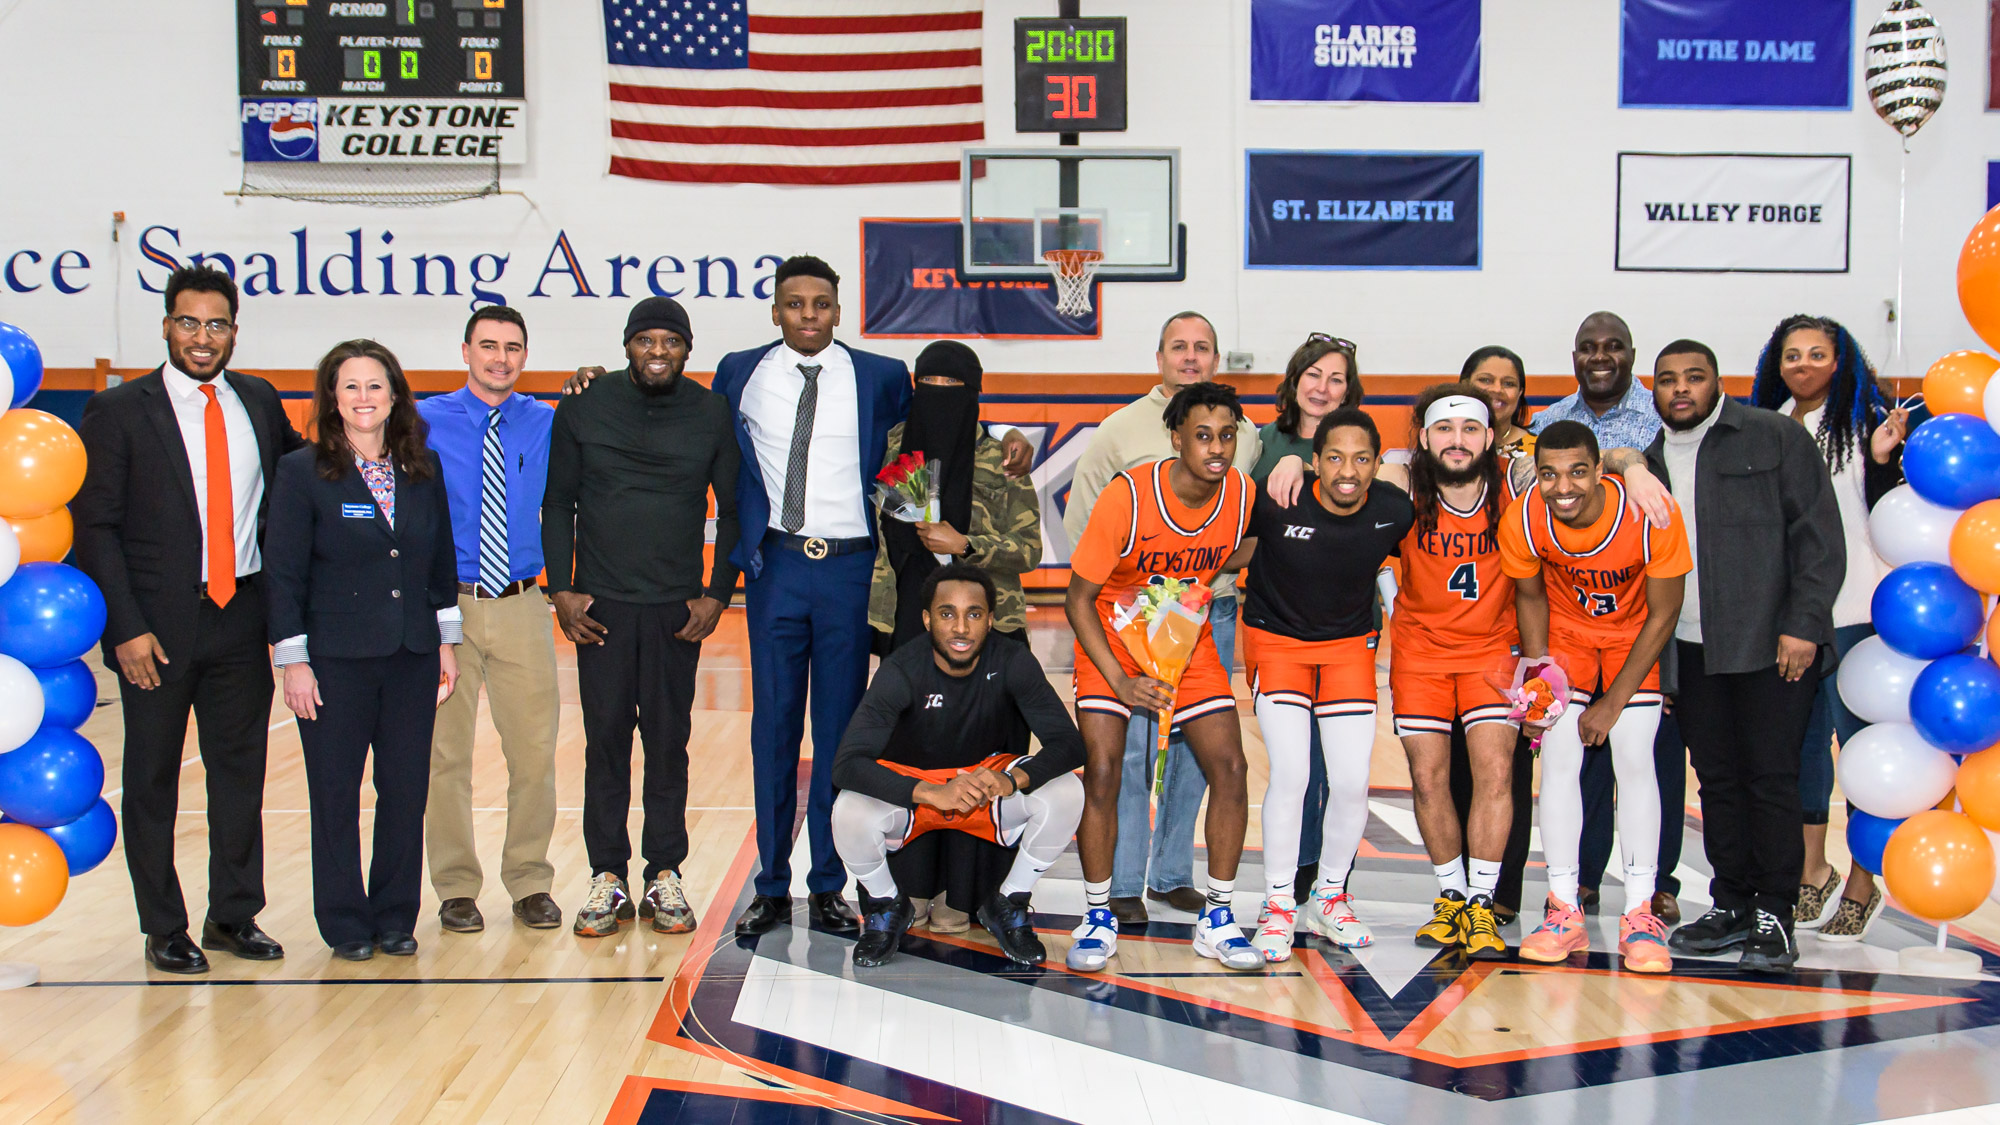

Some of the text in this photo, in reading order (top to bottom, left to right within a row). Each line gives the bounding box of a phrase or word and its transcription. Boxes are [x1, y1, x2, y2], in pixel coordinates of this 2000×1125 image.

[329, 2, 387, 17] PERIOD
[262, 35, 303, 47] FOULS
[339, 35, 424, 48] PLAYER-FOUL
[459, 36, 500, 49] FOULS
[1026, 29, 1115, 63] 20:00
[1314, 24, 1417, 46] CLARKS
[1313, 45, 1418, 68] SUMMIT
[1657, 38, 1816, 63] NOTRE DAME
[277, 49, 297, 78] 0
[474, 51, 493, 80] 0
[261, 79, 307, 92] POINTS
[341, 80, 386, 92] MATCH
[458, 81, 503, 93] POINTS
[1046, 75, 1097, 119] 30
[242, 102, 317, 123] PEPSI
[324, 104, 519, 128] KEYSTONE
[341, 133, 503, 157] COLLEGE
[1272, 199, 1455, 223] ST. ELIZABETH
[1644, 203, 1823, 223] VALLEY FORGE
[0, 249, 91, 295] ce
[528, 229, 785, 300] Arena
[1283, 524, 1316, 540] KC
[1417, 529, 1500, 558] KEYSTON
[1136, 545, 1228, 573] KEYSTONE
[1447, 561, 1479, 601] 4
[1548, 560, 1636, 590] YSTONE
